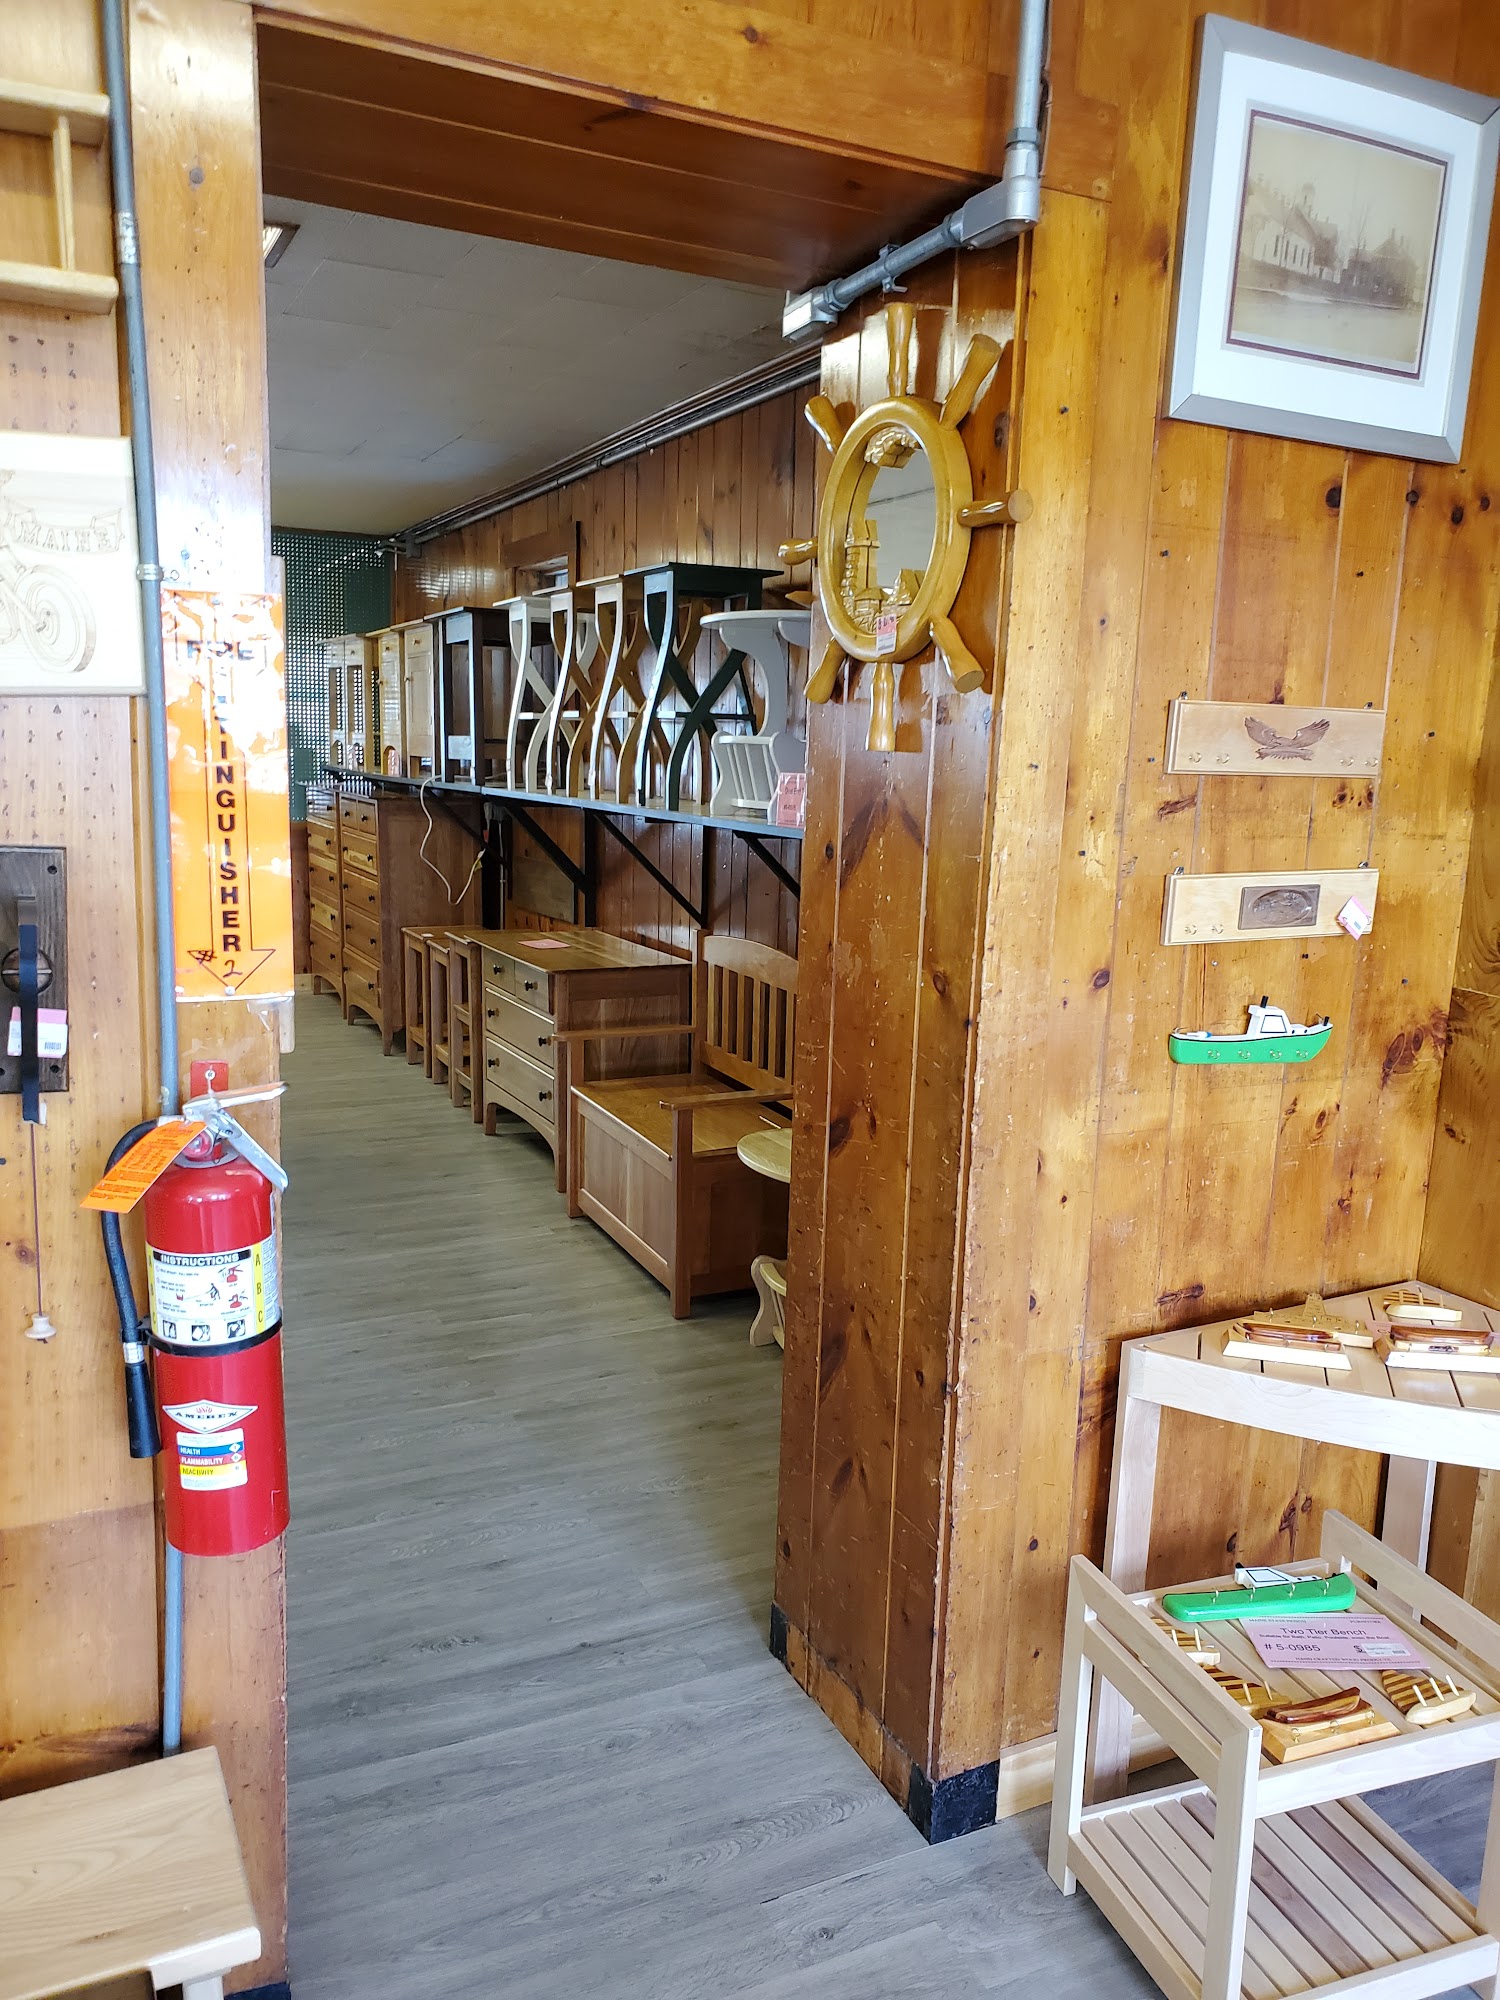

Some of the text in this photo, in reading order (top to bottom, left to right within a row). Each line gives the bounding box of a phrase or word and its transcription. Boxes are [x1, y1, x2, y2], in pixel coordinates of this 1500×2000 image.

[18, 520, 113, 553] MAINE
[186, 640, 255, 660] FRE
[160, 1253, 240, 1267] INSTRUCTIONS
[255, 1253, 261, 1267] A
[256, 1282, 262, 1295] B
[257, 1310, 263, 1323] C
[180, 1447, 201, 1456] HEALTH
[181, 1456, 223, 1466] FLAMMABILITY
[1280, 1627, 1305, 1635] Two
[1276, 1643, 1321, 1652] 5-0985
